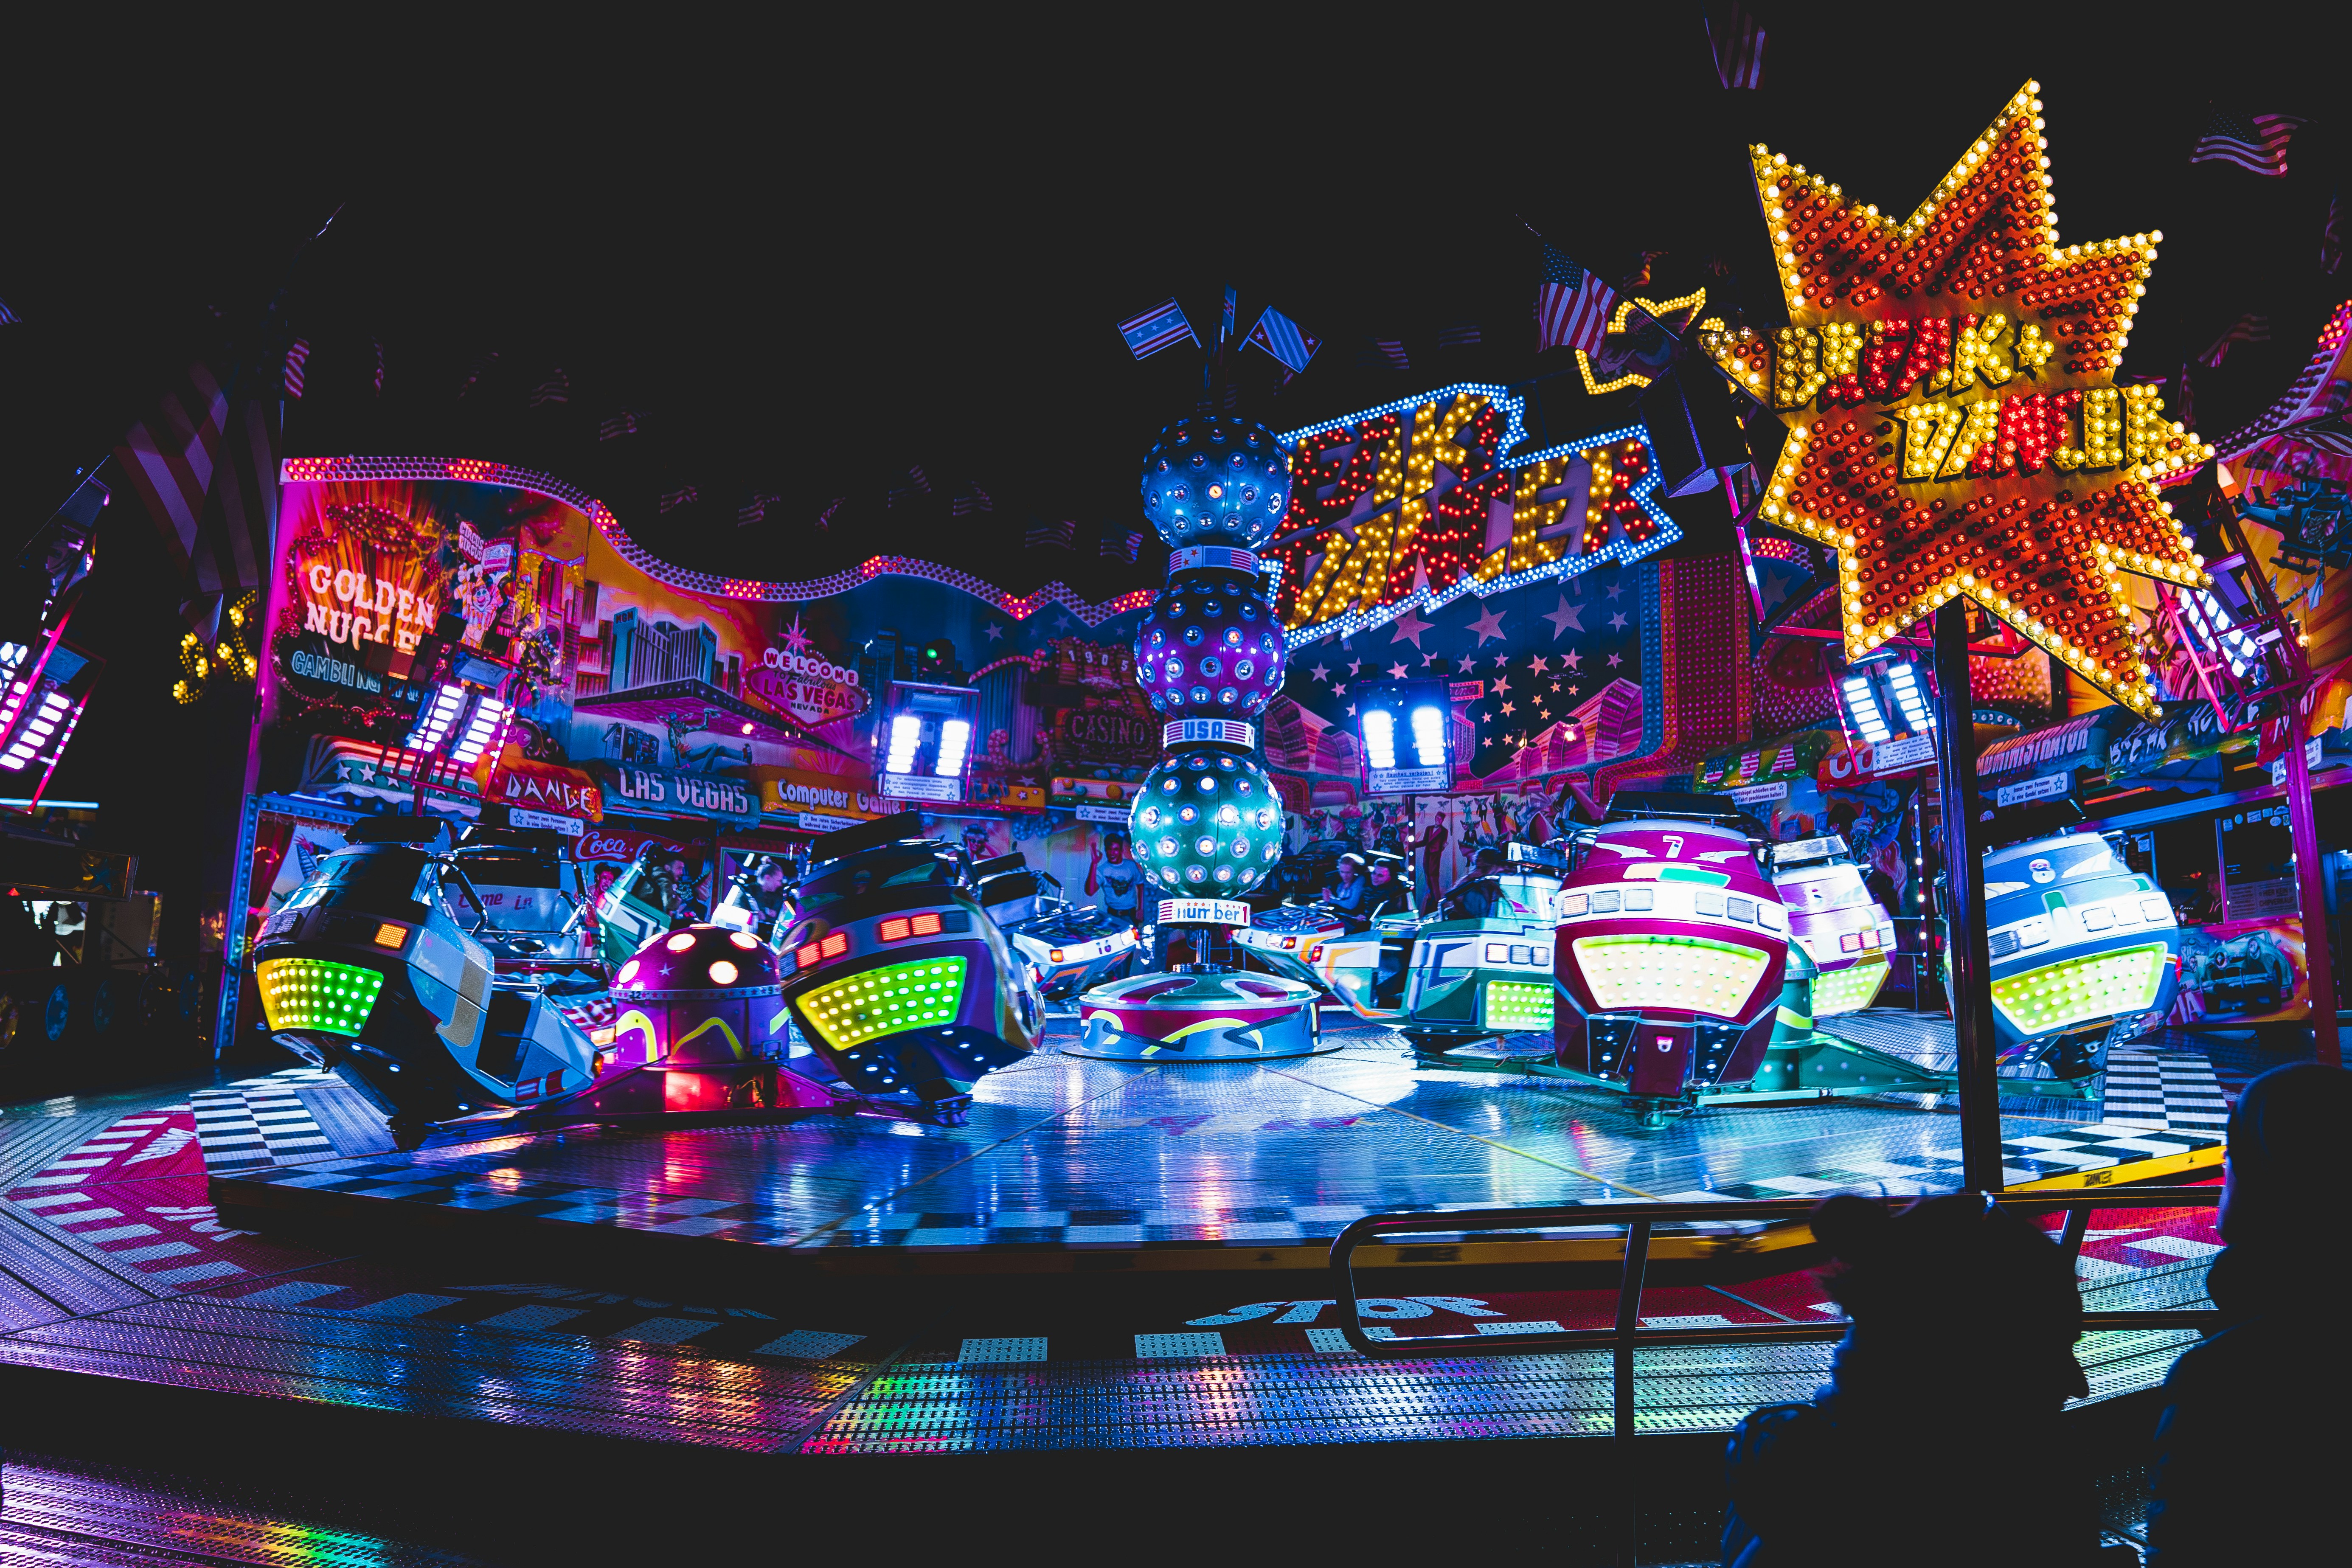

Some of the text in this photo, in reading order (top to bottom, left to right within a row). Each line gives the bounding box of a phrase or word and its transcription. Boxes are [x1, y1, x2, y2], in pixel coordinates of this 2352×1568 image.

[1773, 312, 2015, 413] BREAK
[1878, 384, 2170, 485] DANCER
[458, 535, 482, 561] CIRCUS
[459, 521, 484, 551] CIRCUS
[1257, 437, 1662, 632] DANCER
[309, 565, 436, 629] GOLDEN
[616, 610, 633, 624] MGM
[766, 652, 855, 683] WELCOME
[1068, 650, 1129, 672] 1905
[764, 679, 855, 711] LAS VEGAS
[773, 671, 836, 691] TO Fabulous
[791, 702, 829, 714] NEVADA
[1071, 715, 1145, 745] CASINO
[1183, 722, 1223, 739] USA
[1703, 744, 1796, 783] USA
[619, 767, 749, 814] LAS VEGAS
[777, 778, 849, 810] Computer
[1748, 794, 1770, 802] geschlossen
[1662, 835, 1684, 858] 7
[2029, 858, 2056, 884] 8
[458, 893, 503, 908] Cme
[1177, 902, 1248, 923] number 1
[1183, 1296, 1508, 1325] STOP
